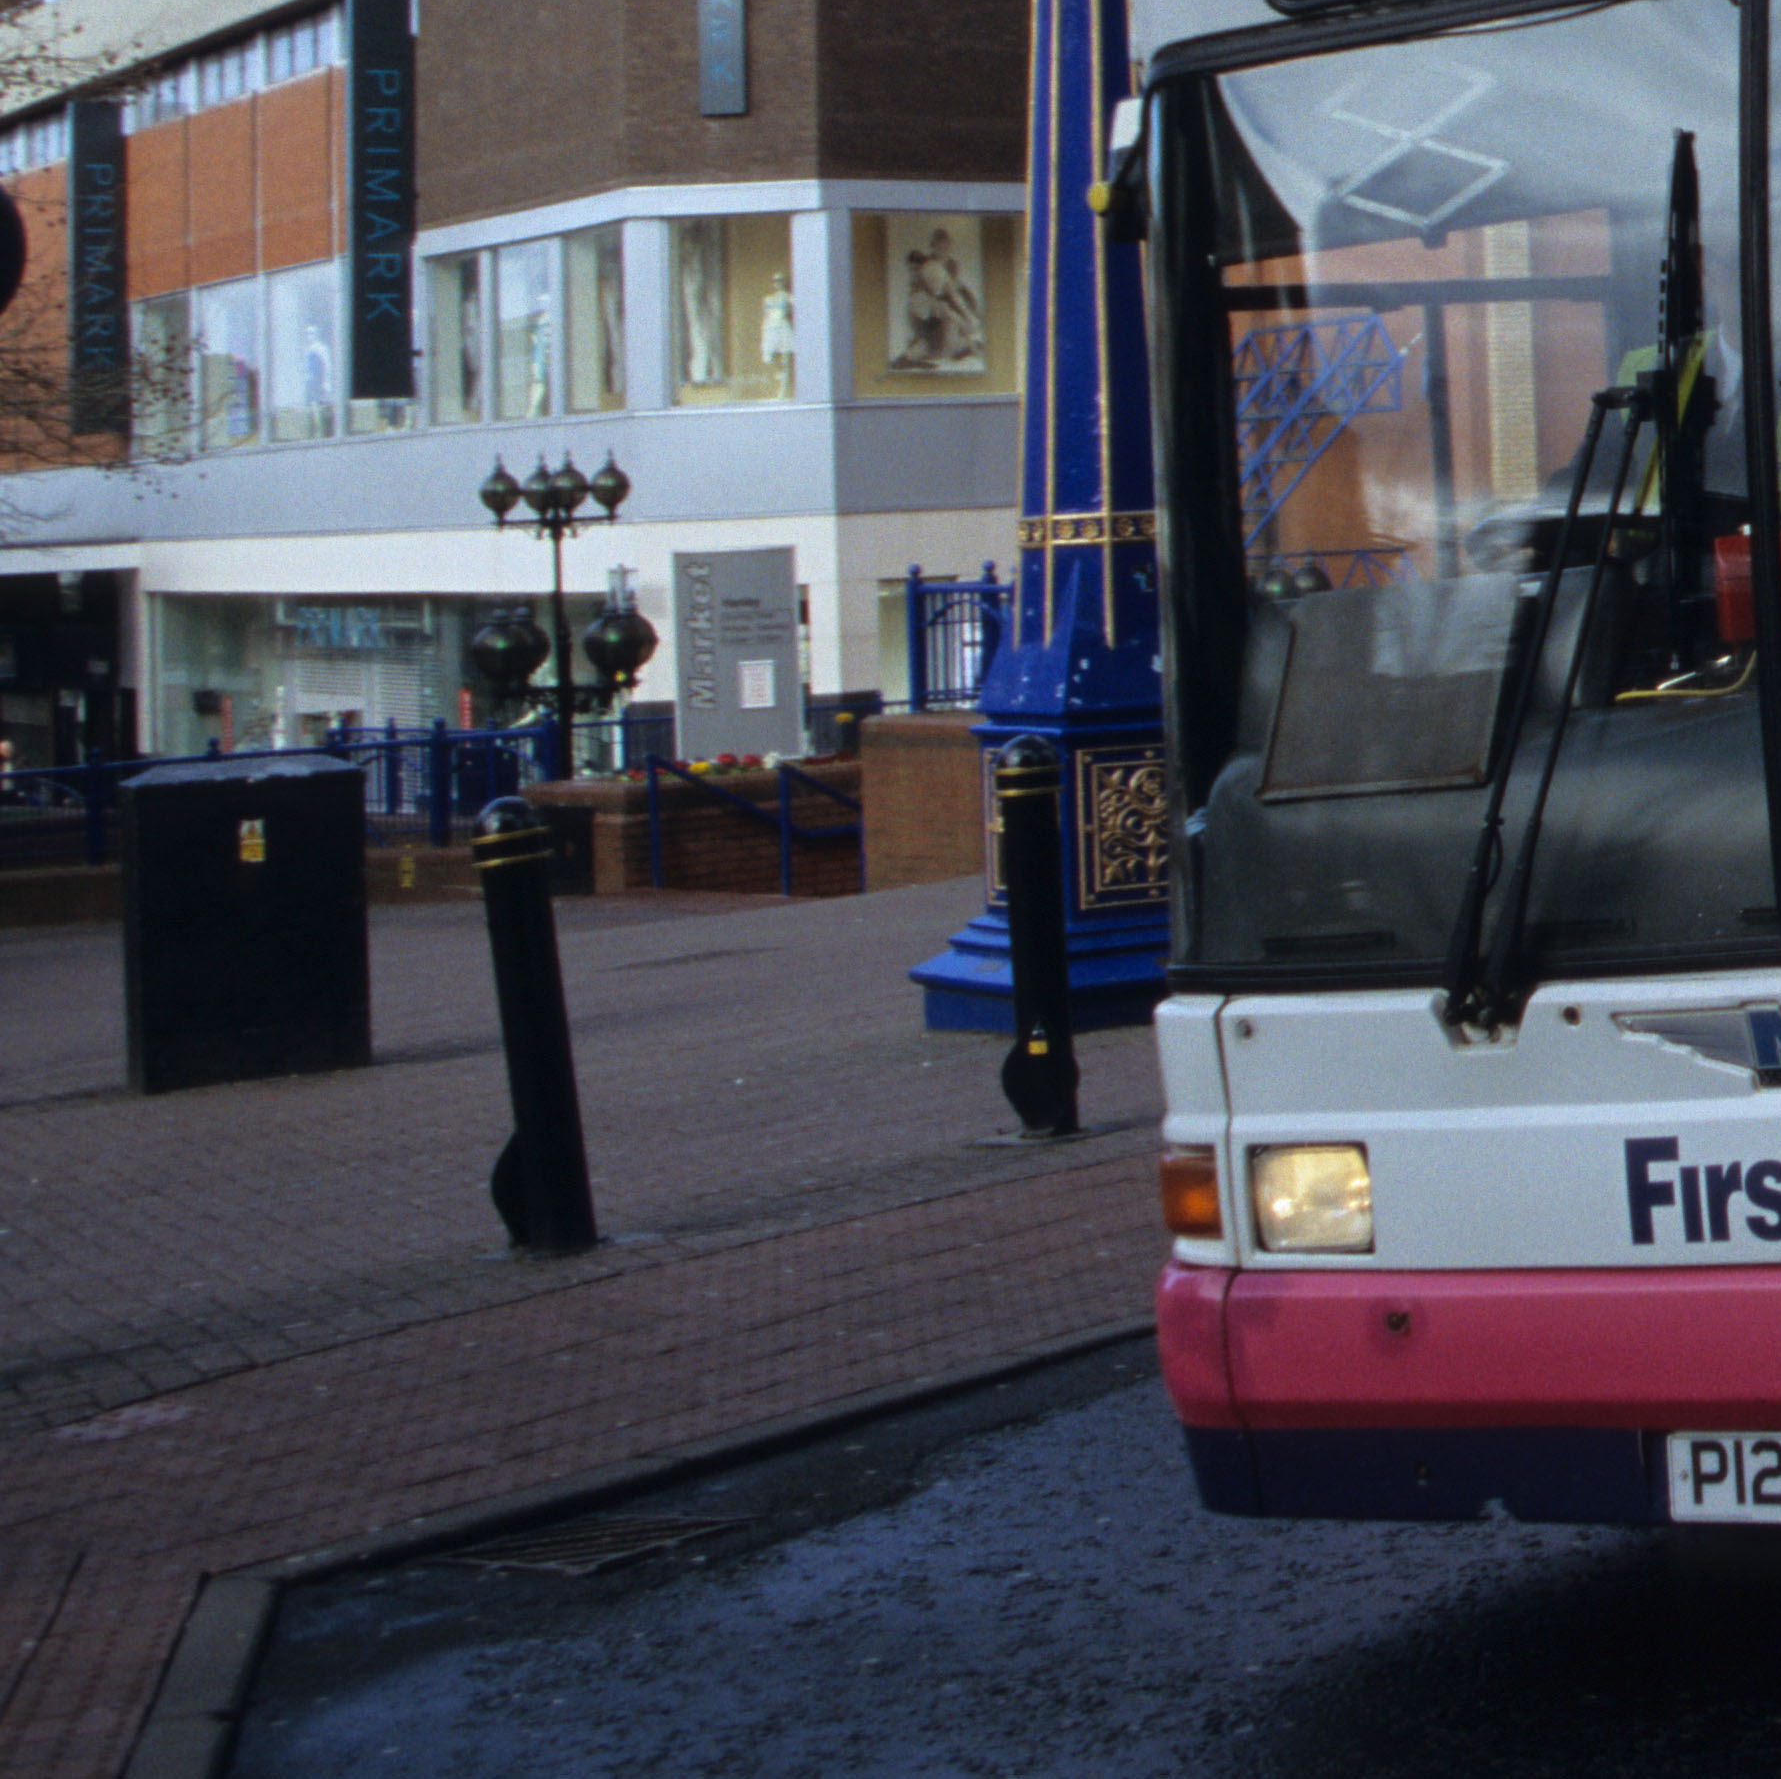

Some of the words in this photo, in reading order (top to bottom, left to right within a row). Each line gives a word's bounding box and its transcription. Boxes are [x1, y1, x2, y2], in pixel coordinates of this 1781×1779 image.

[83, 164, 115, 369] PRIMARK
[364, 69, 400, 319] PRIMARK
[685, 561, 717, 710] Market
